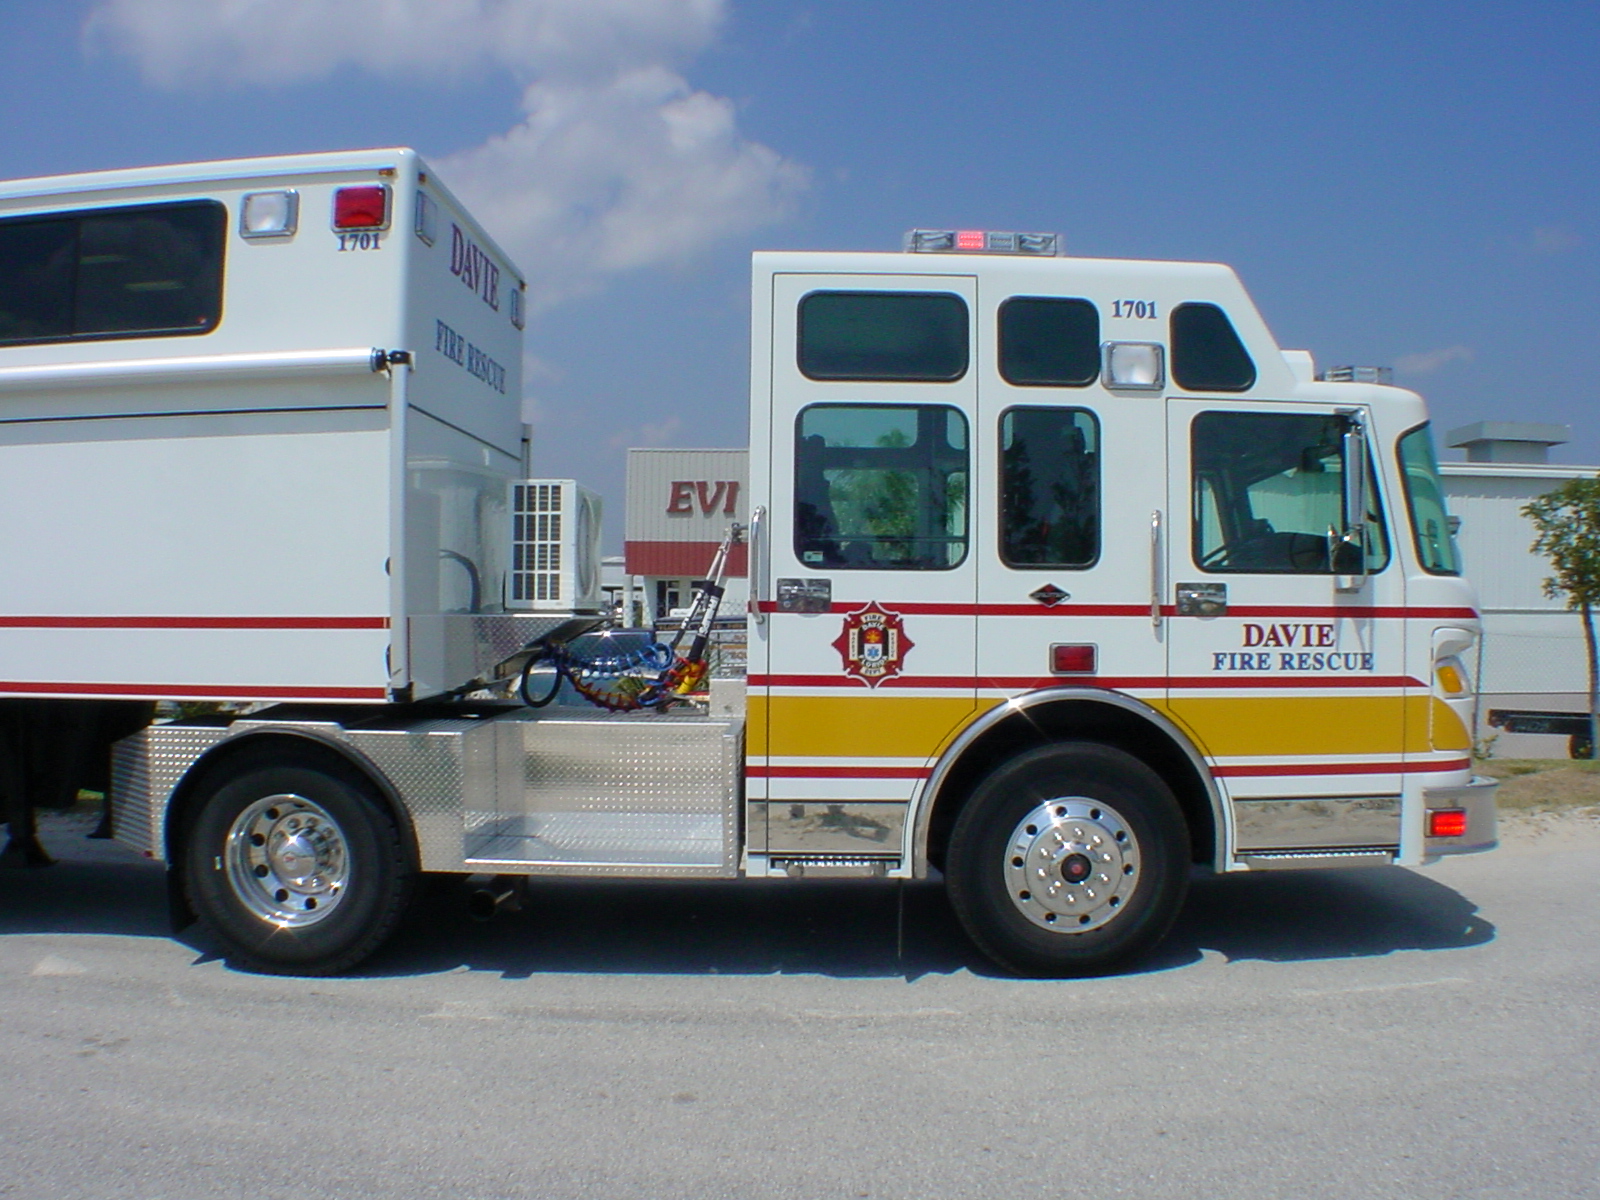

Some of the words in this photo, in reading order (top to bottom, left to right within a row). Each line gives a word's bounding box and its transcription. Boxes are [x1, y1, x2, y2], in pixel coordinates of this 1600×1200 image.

[337, 232, 381, 251] 1701
[450, 222, 499, 312] DAVIE
[1111, 299, 1157, 319] 1701
[436, 318, 465, 367] FIRE
[467, 342, 506, 395] RESCUE
[666, 480, 740, 513] EVI
[1242, 623, 1335, 648] DAVIE
[1212, 652, 1271, 671] FIRE
[1278, 652, 1374, 671] RESCUE
